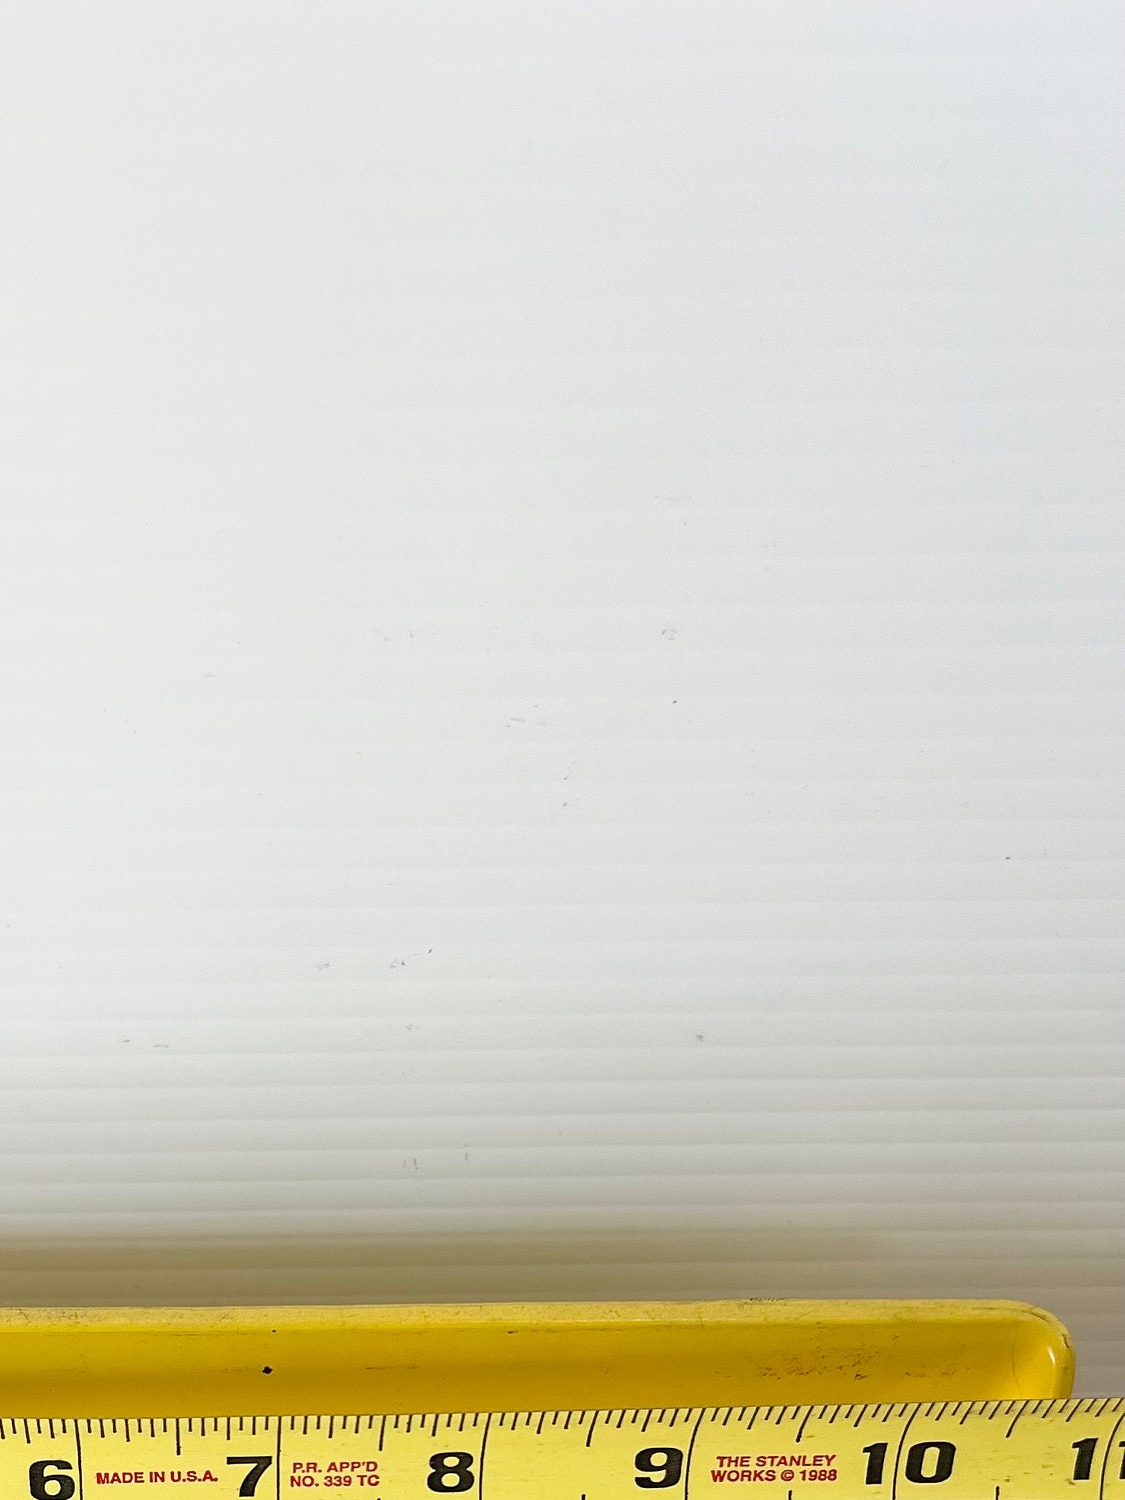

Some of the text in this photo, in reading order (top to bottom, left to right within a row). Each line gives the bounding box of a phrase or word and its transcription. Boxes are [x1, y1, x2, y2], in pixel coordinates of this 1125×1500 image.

[292, 1461, 378, 1473] P.R. APP'D
[633, 1446, 684, 1489] 9
[716, 1454, 837, 1468] THE STANLEY
[862, 1440, 957, 1485] 10
[96, 1470, 219, 1485] MADE IN U.S.A.
[226, 1455, 273, 1498] 7
[426, 1451, 475, 1494] 8
[710, 1469, 776, 1482] WORKS
[799, 1468, 838, 1482] 1988
[290, 1474, 380, 1487] NO. 339 TC
